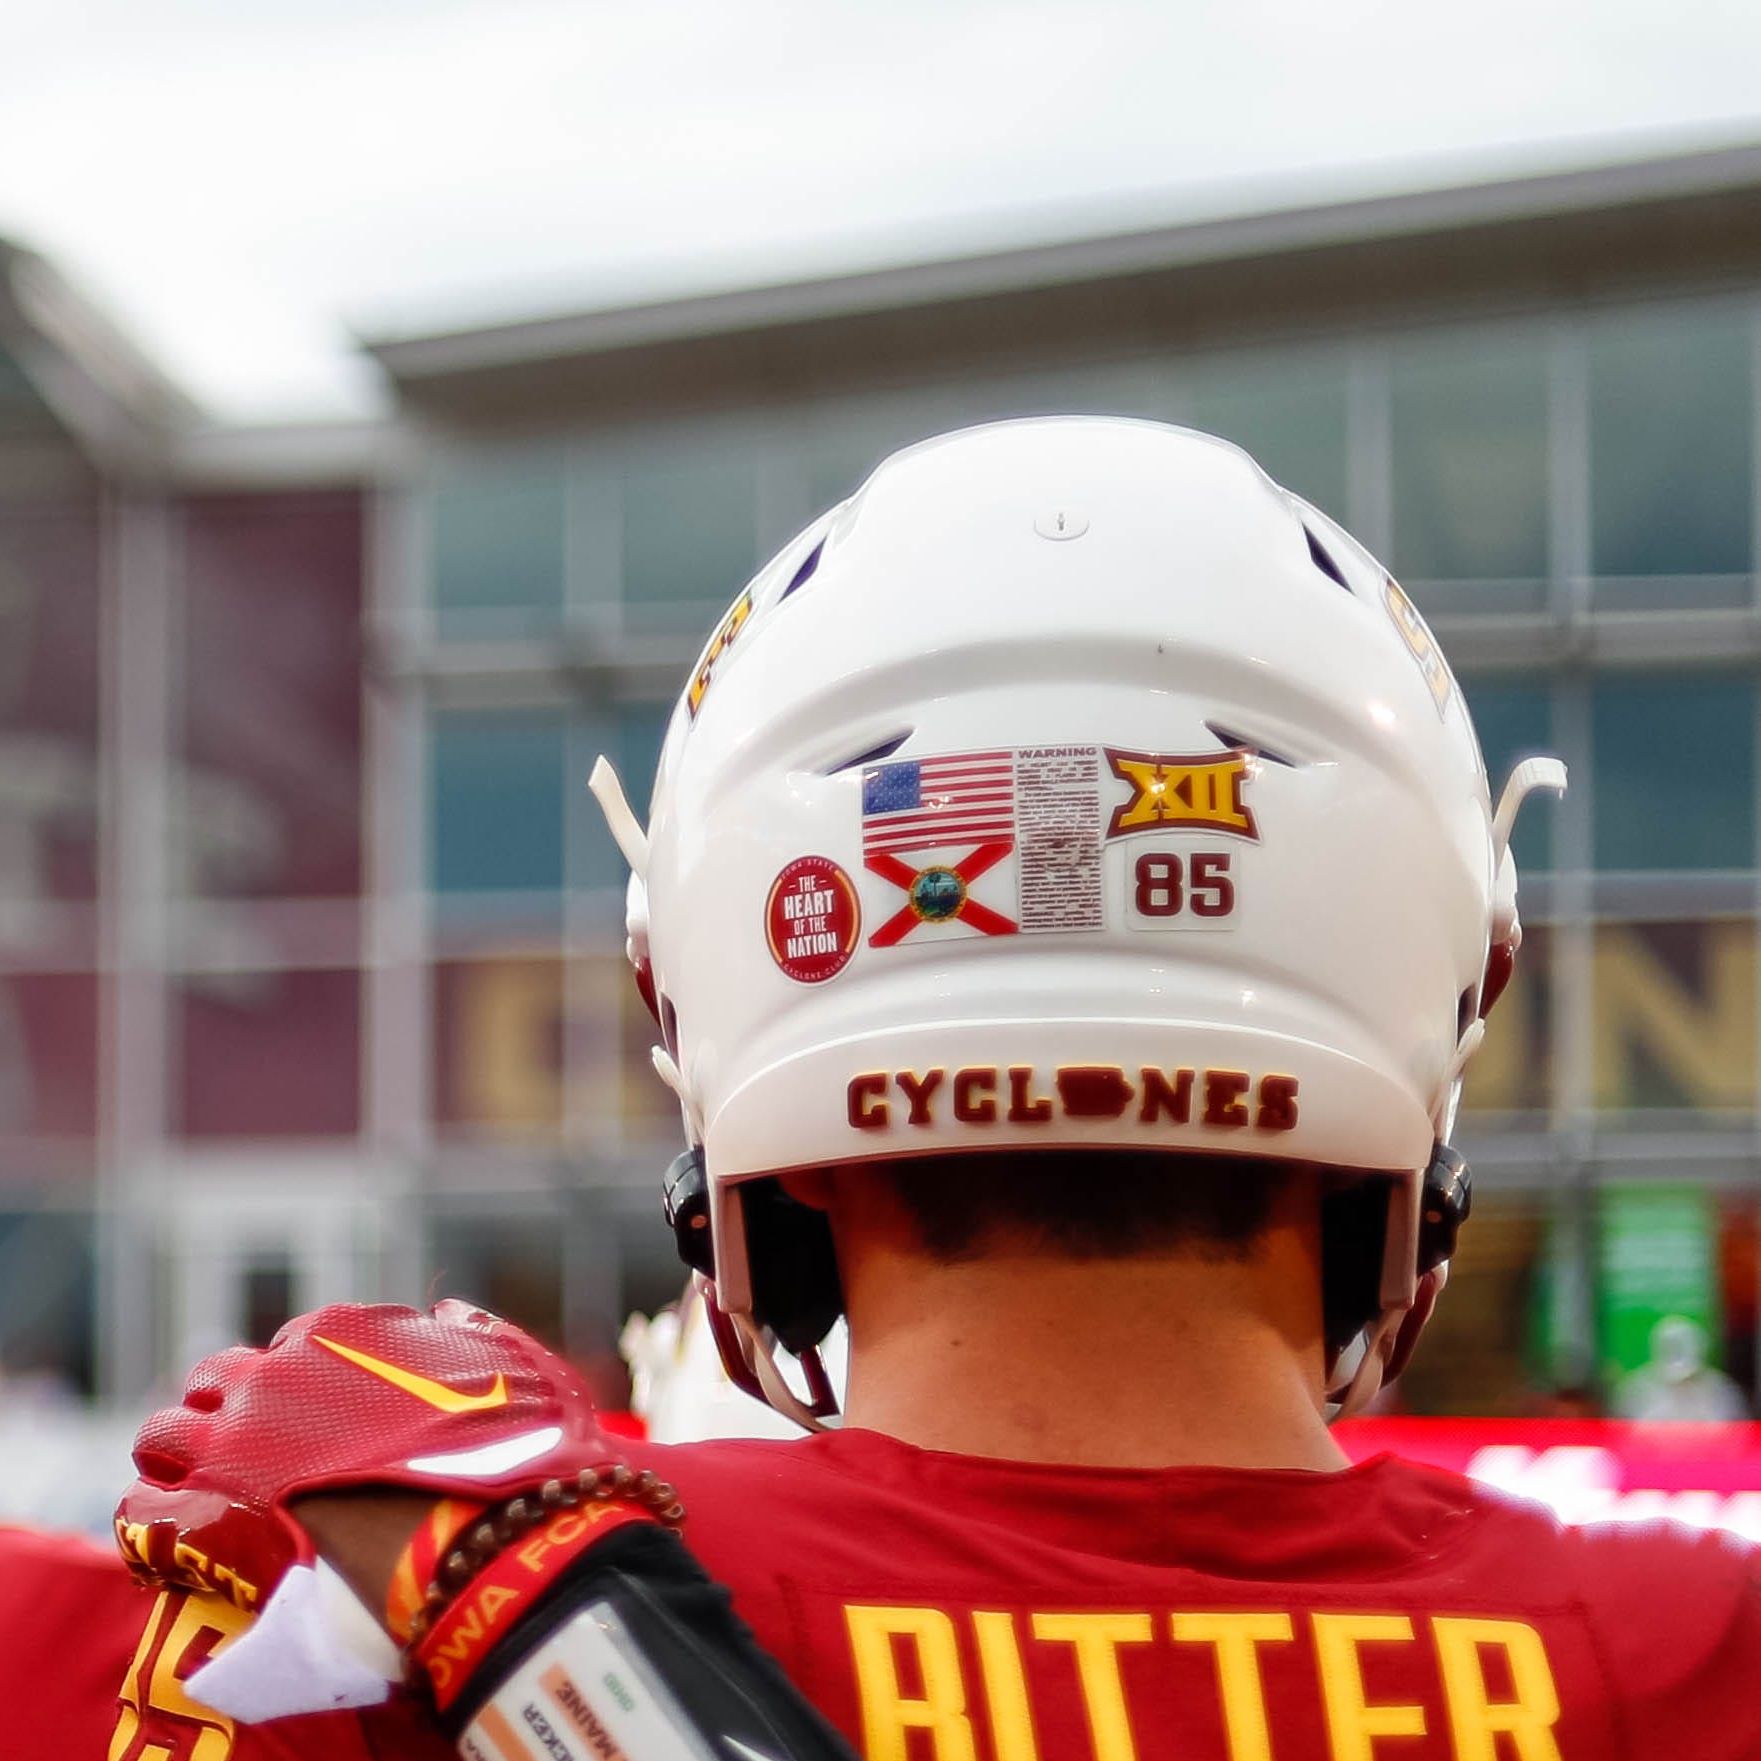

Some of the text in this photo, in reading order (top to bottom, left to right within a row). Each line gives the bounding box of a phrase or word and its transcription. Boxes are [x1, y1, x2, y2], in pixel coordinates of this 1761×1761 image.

[1019, 747, 1097, 758] WARNING
[799, 875, 816, 892] THE
[1133, 852, 1236, 919] 85
[783, 889, 834, 919] HEART
[794, 916, 827, 935] OF THE
[787, 932, 838, 959] NATION
[428, 1585, 521, 1689] OWA
[553, 1679, 620, 1761] MAINE
